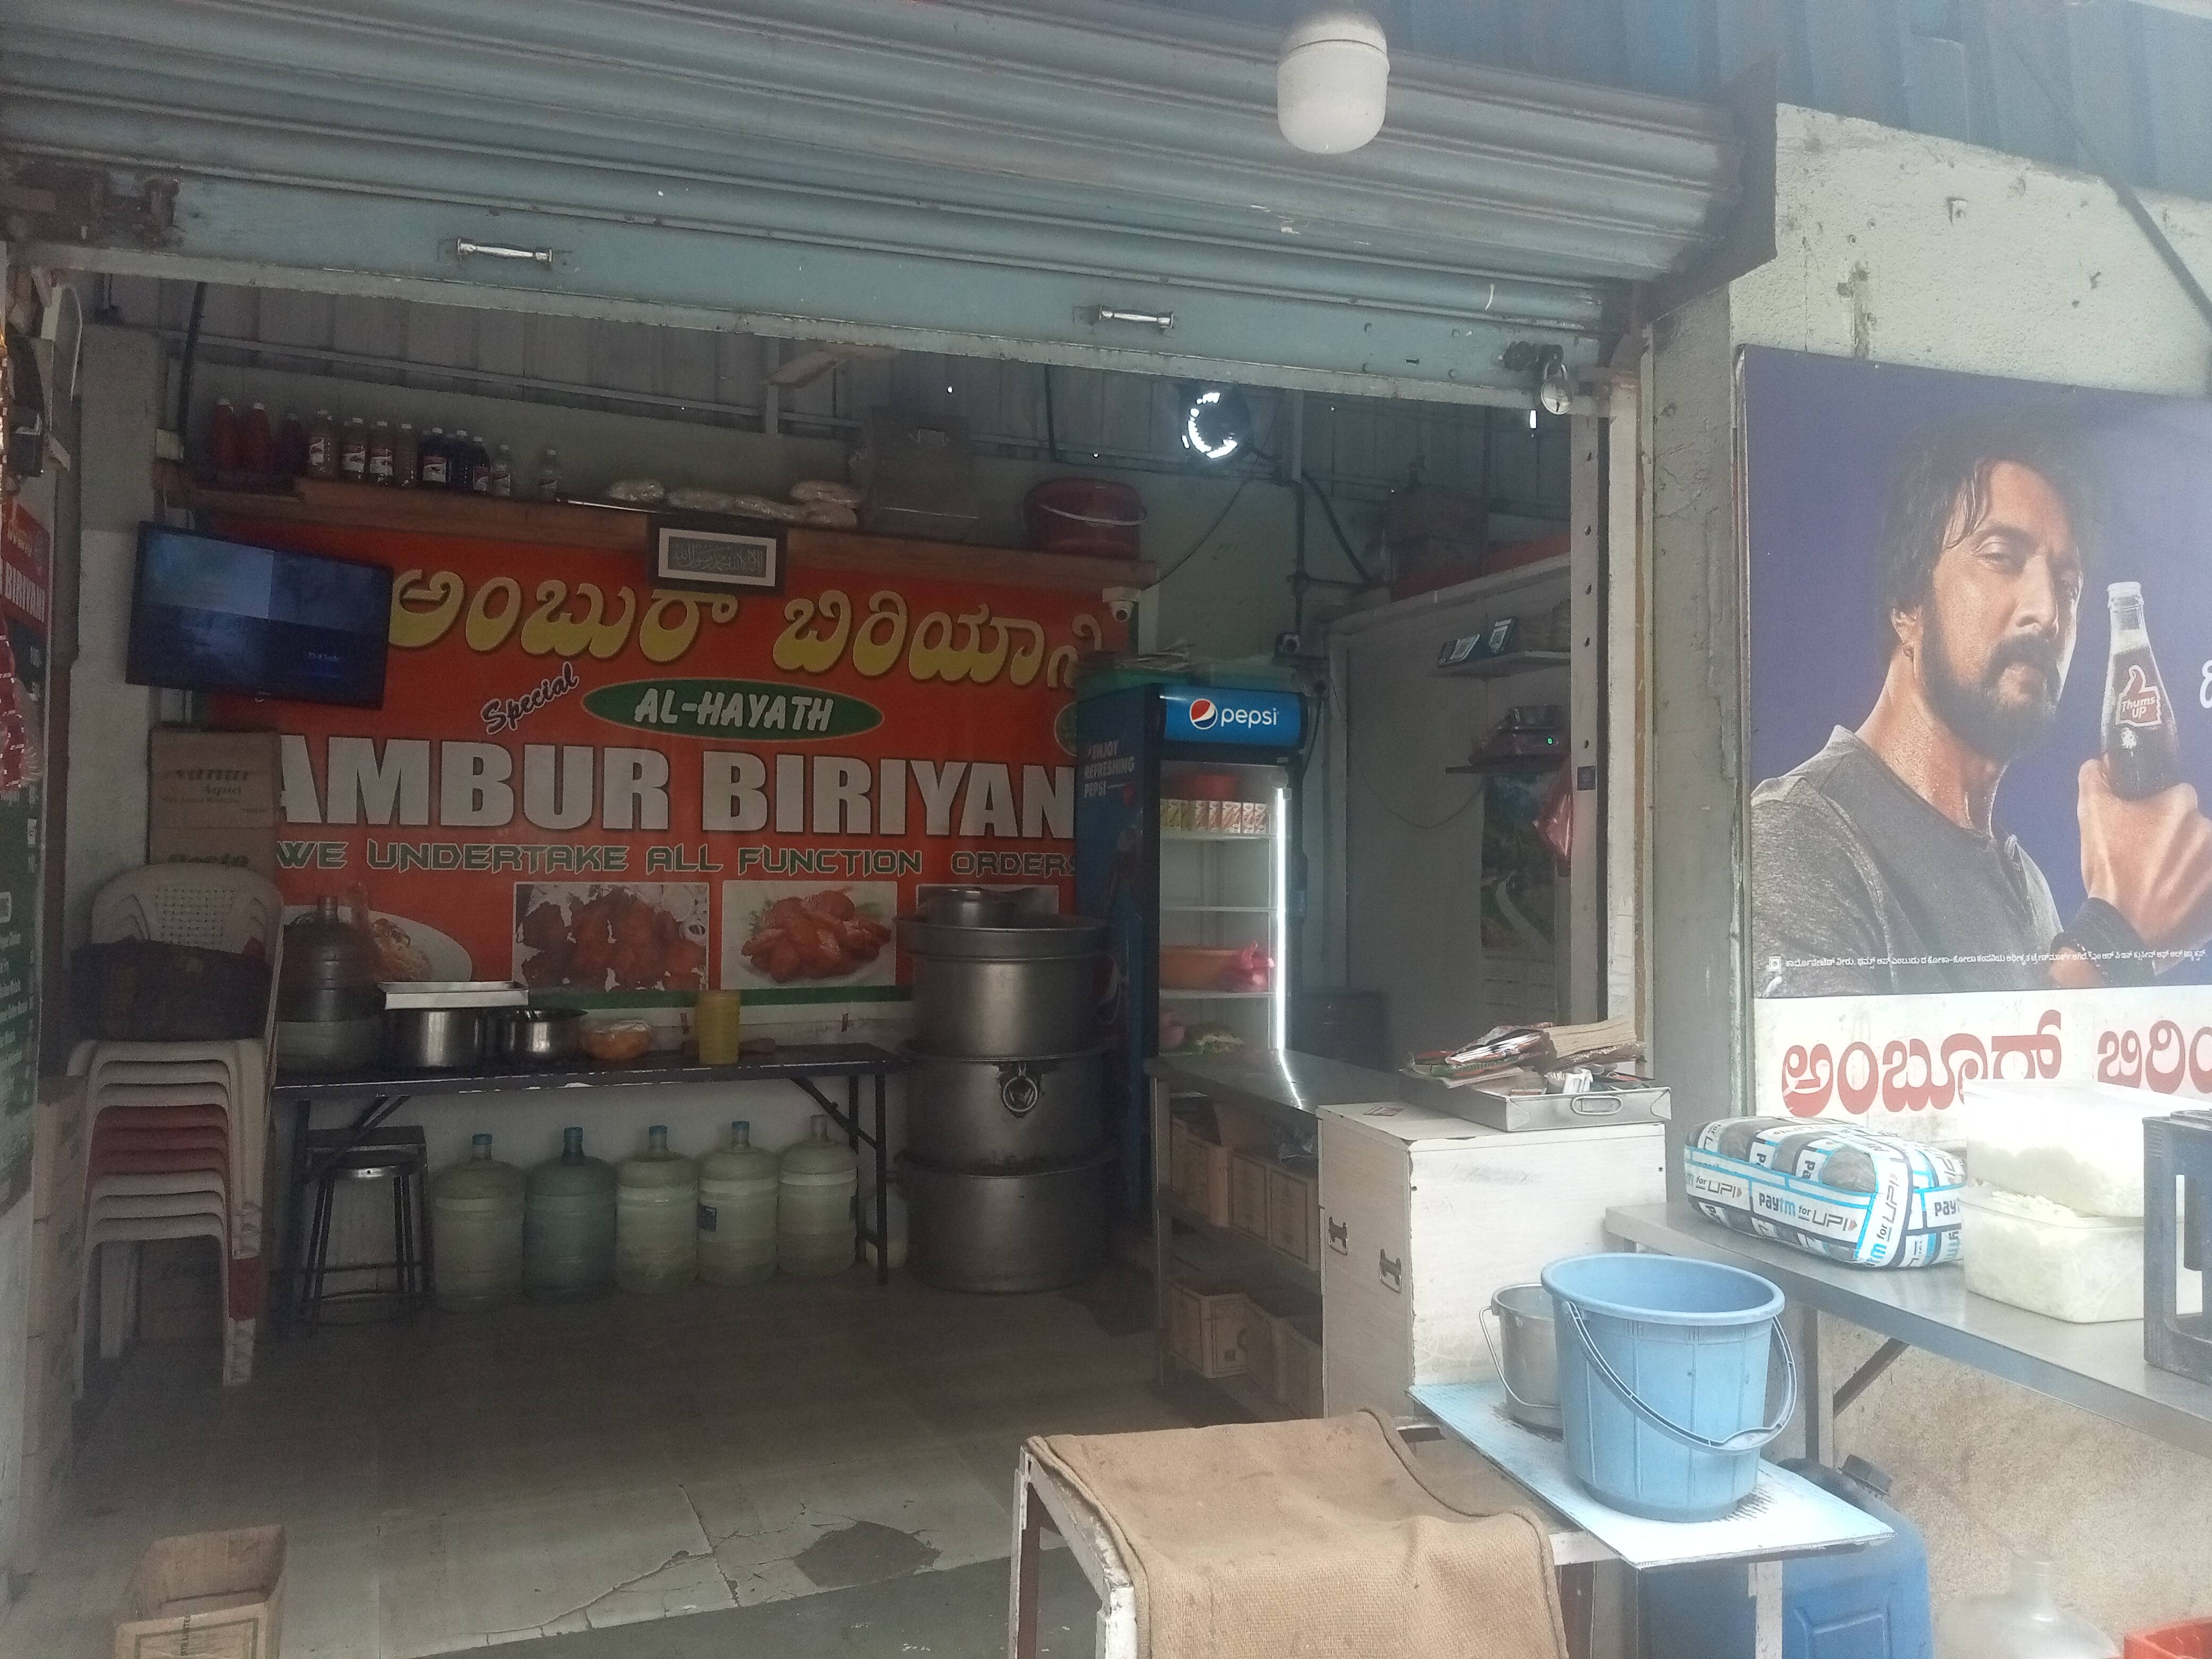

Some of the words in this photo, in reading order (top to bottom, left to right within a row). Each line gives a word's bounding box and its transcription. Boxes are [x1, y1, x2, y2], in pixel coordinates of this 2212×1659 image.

[480, 661, 580, 735] Special
[634, 688, 834, 732] AL-HAYATH
[2121, 696, 2156, 713] Thums
[1221, 707, 1277, 728] pepsi
[281, 735, 669, 831] AMBUR
[276, 840, 349, 869] WE
[367, 839, 630, 875] UNDERTAKE
[646, 842, 723, 875] ALL
[736, 845, 923, 877] FUNCTION
[1695, 1176, 1707, 1185] for
[1707, 1180, 1736, 1199] UPI
[1798, 1205, 1811, 1216] for
[1812, 1210, 1849, 1231] UPI
[1876, 1223, 1888, 1240] for
